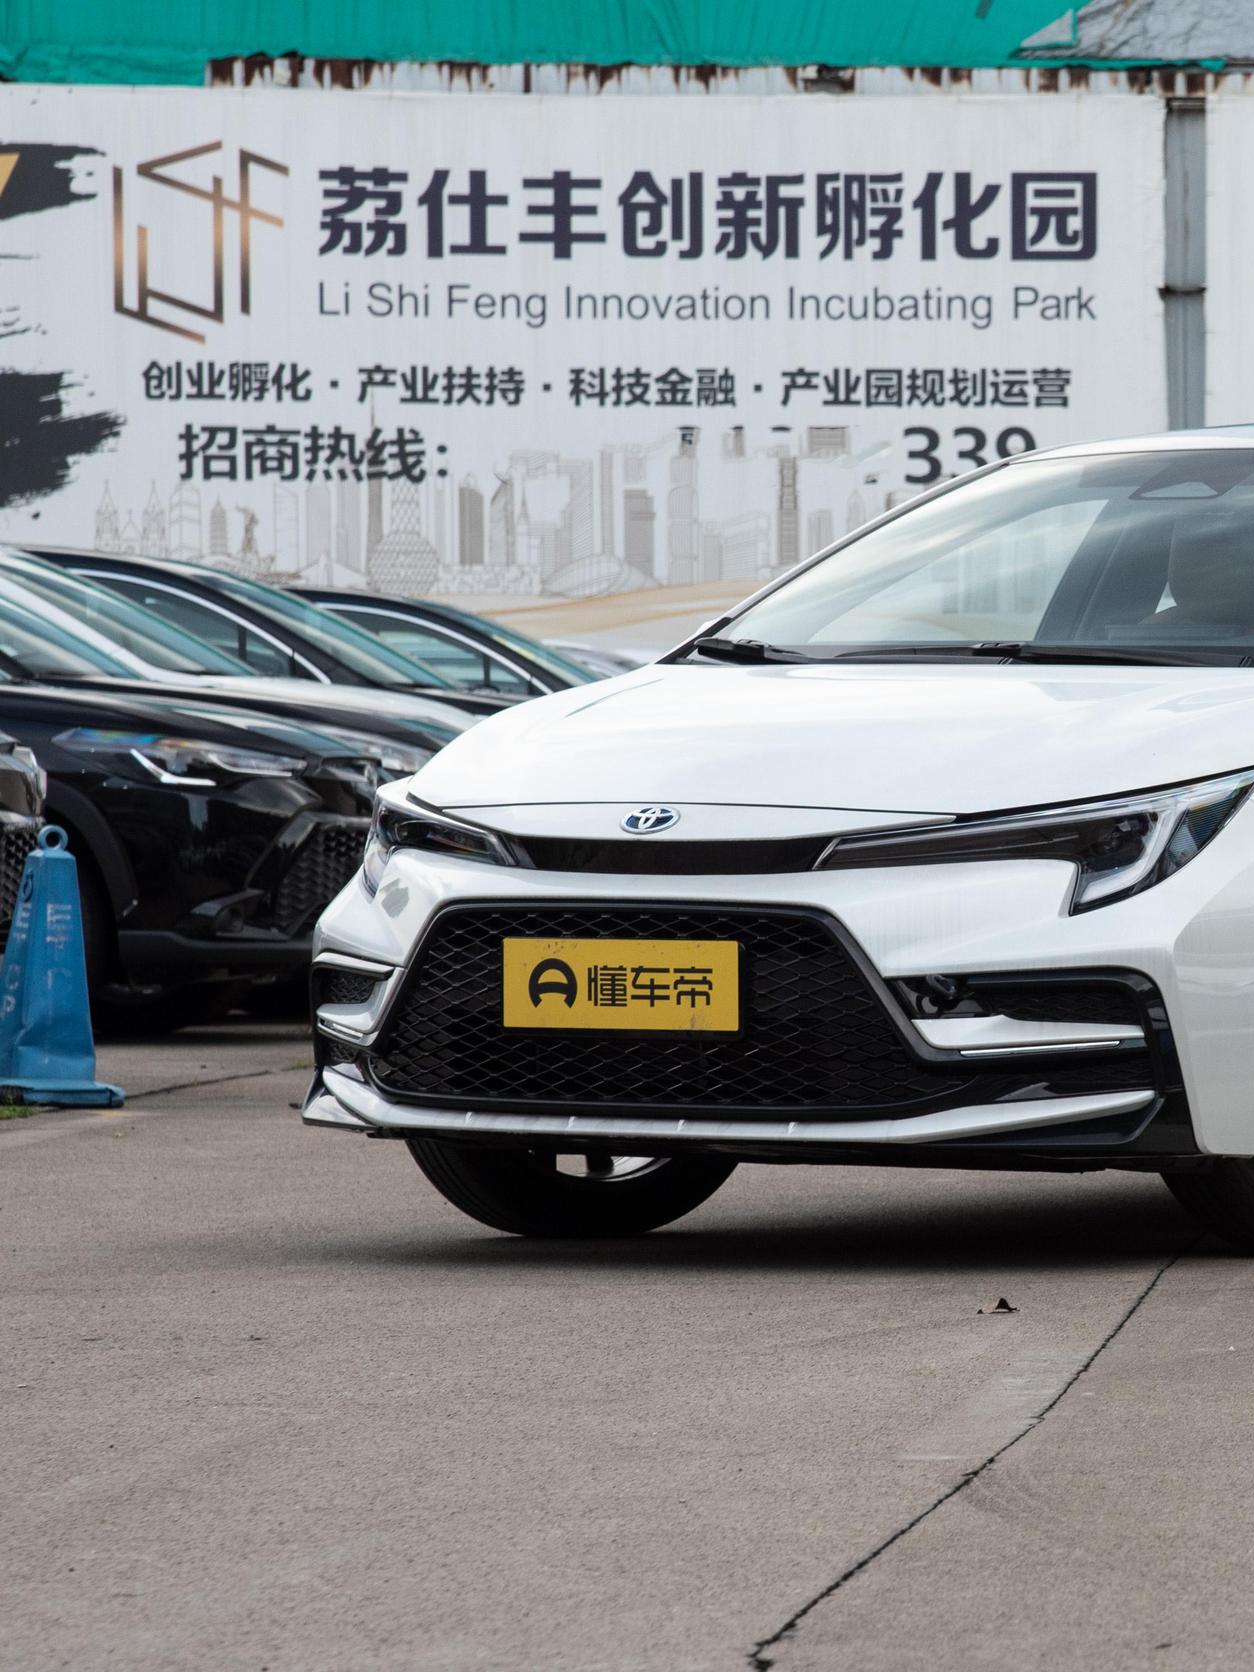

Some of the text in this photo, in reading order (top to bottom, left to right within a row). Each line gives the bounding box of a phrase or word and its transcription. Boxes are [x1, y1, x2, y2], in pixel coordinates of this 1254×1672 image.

[319, 166, 1096, 261] 荔仕丰创新孵化园
[319, 282, 1097, 331] Li Shi Feng Innovation Incubating Park
[588, 965, 713, 1008] 懂车帝
